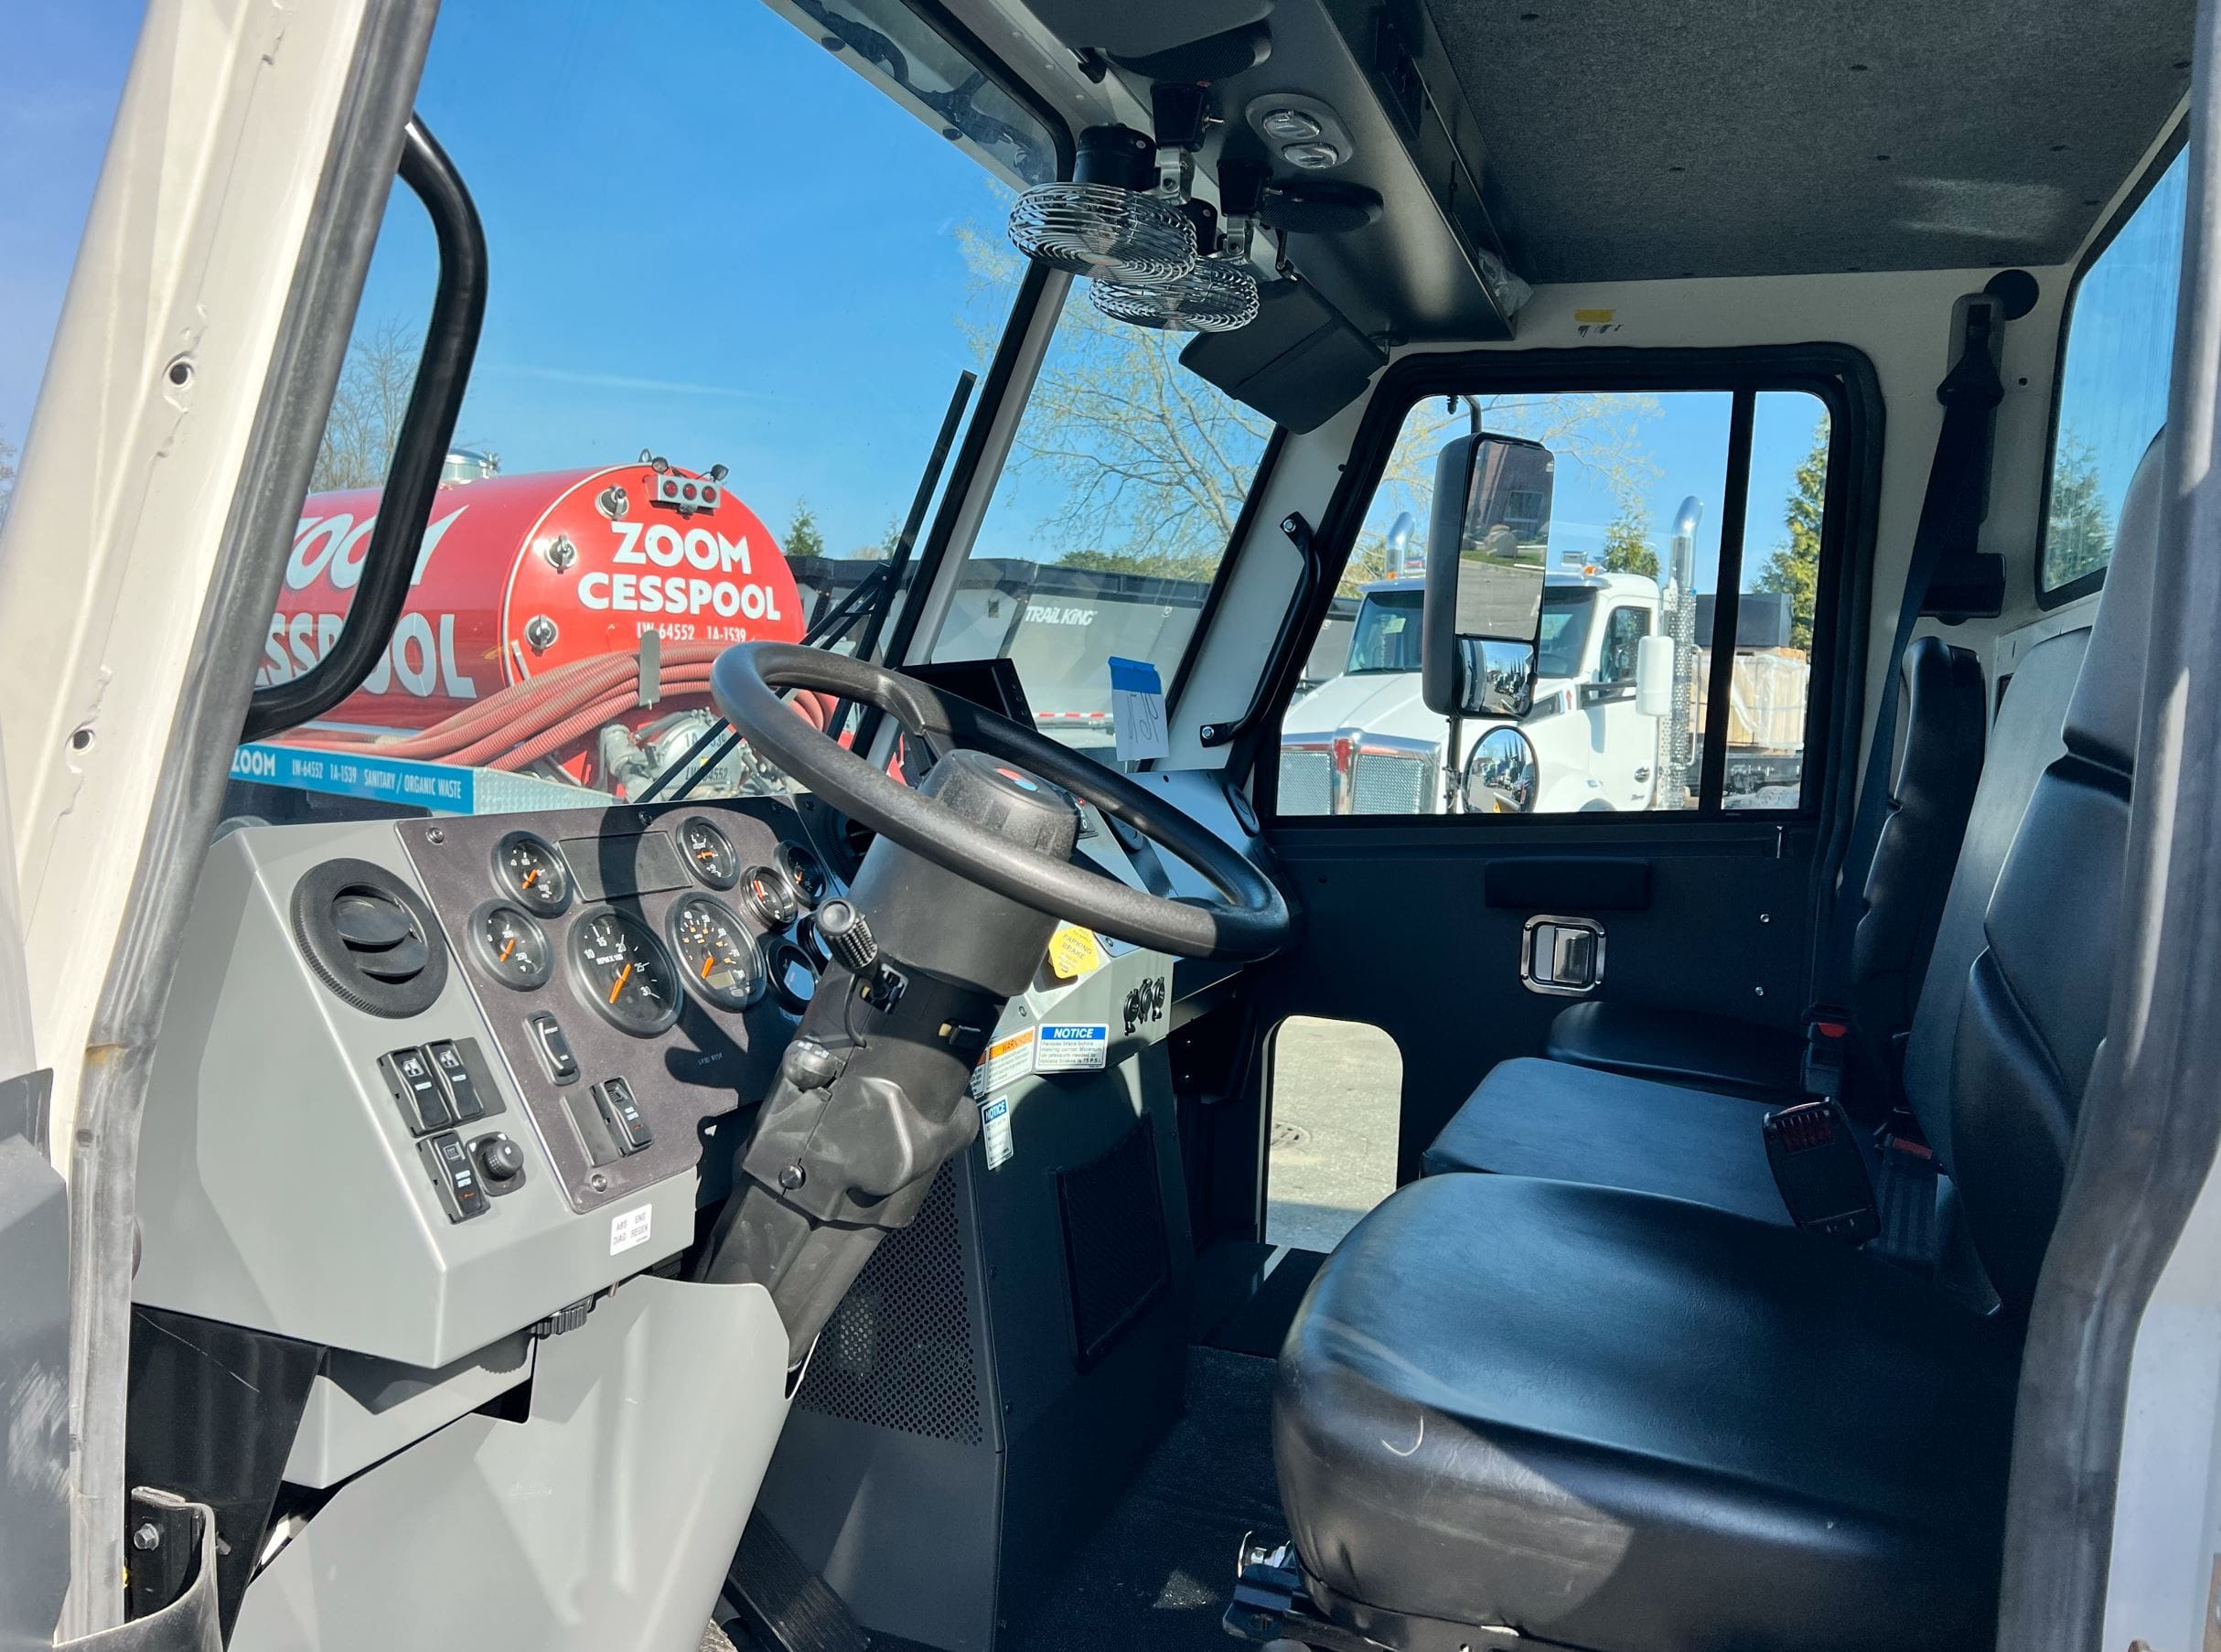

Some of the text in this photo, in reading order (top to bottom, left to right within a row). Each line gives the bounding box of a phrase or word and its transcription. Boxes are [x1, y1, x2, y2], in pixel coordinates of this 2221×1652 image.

[611, 520, 752, 574] ZOOM
[577, 572, 781, 621] CESSPOOL
[637, 621, 695, 641] LW64552
[231, 748, 275, 778] ZOOM
[364, 768, 396, 790] SANITARY
[403, 774, 436, 796] ORGANIC
[437, 778, 462, 799] WASTE
[1061, 943, 1086, 960] BRAKE
[1062, 933, 1093, 954] PARKING
[584, 949, 595, 960] 10
[1053, 1027, 1094, 1039] NOTICE
[985, 1101, 1006, 1122] NOTICE
